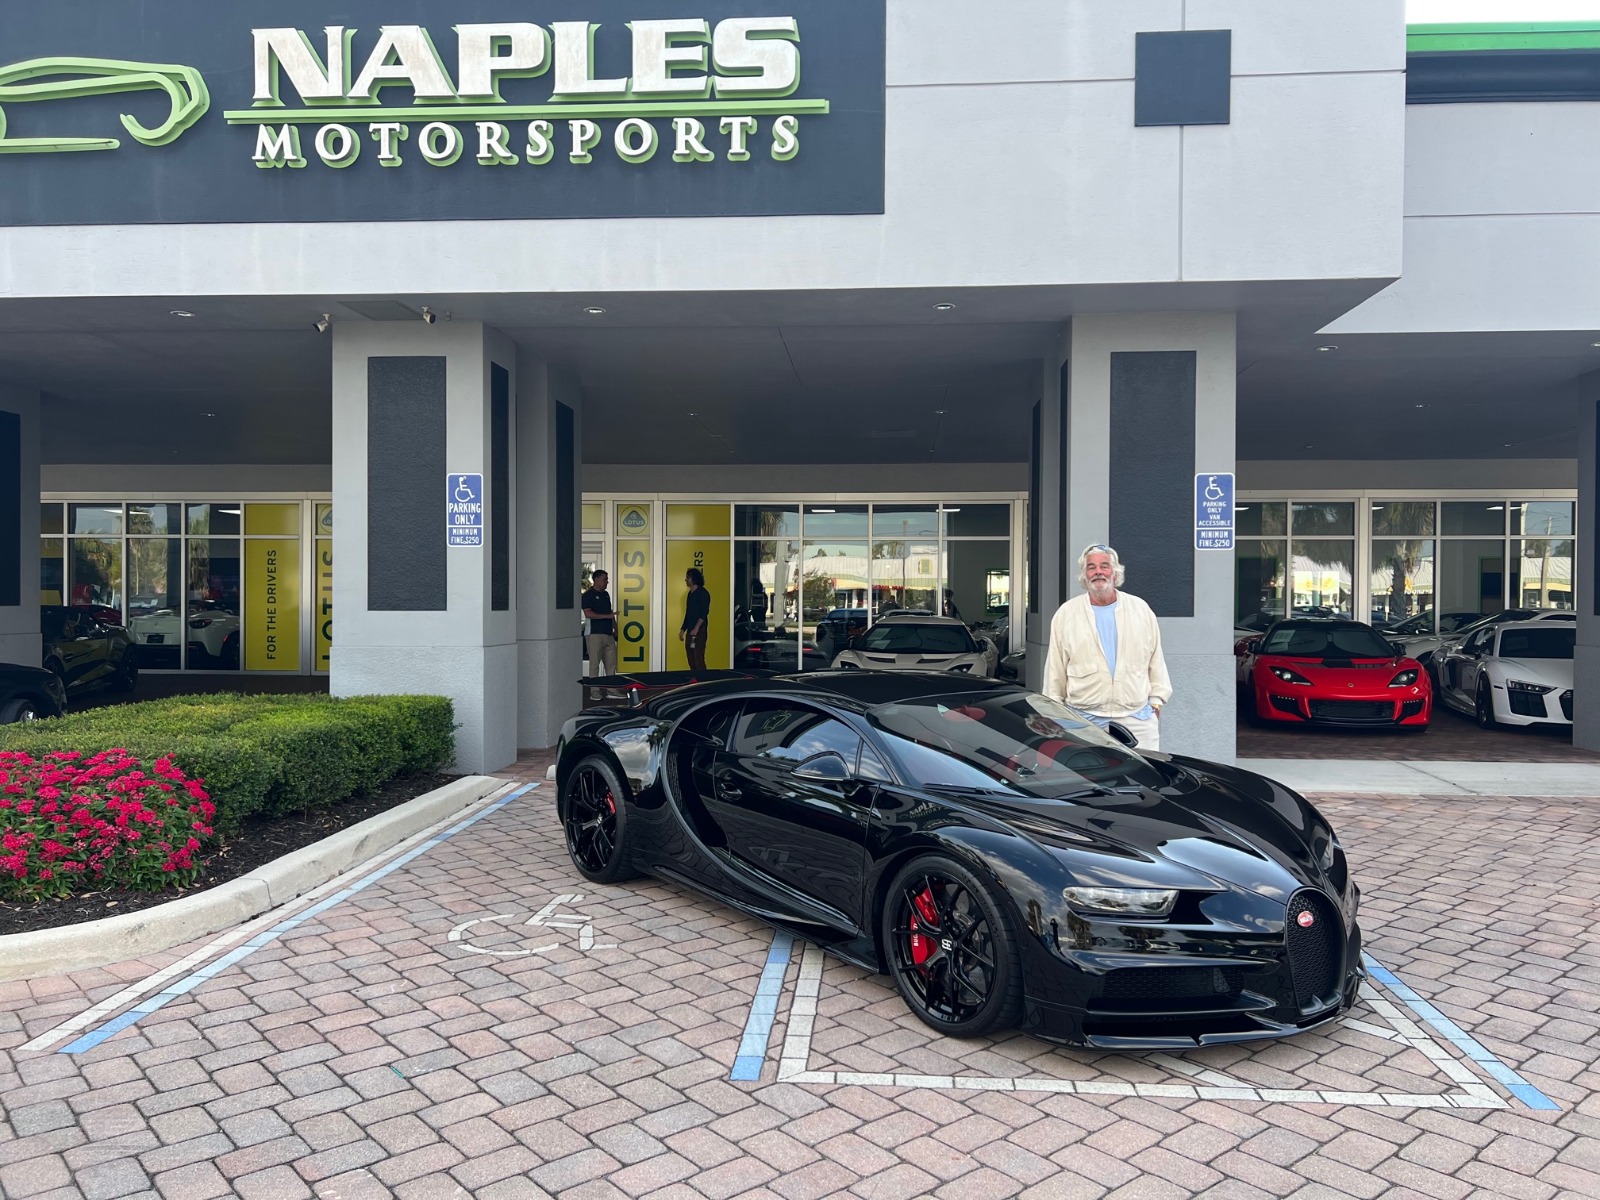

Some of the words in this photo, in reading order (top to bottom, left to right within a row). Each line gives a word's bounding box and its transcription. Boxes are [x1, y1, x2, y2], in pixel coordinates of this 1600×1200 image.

[252, 16, 800, 105] NAPLES
[253, 115, 800, 169] MOTORSPORTS
[448, 502, 481, 513] PARKING
[455, 514, 475, 524] ONLY
[450, 536, 464, 544] FINE
[465, 536, 480, 544] $250
[1199, 539, 1213, 547] FINE
[1215, 539, 1230, 547] $250
[267, 550, 276, 604] DRIVERS
[623, 551, 645, 662] LOTUS
[267, 608, 276, 632] THE
[267, 635, 276, 660] FOR
